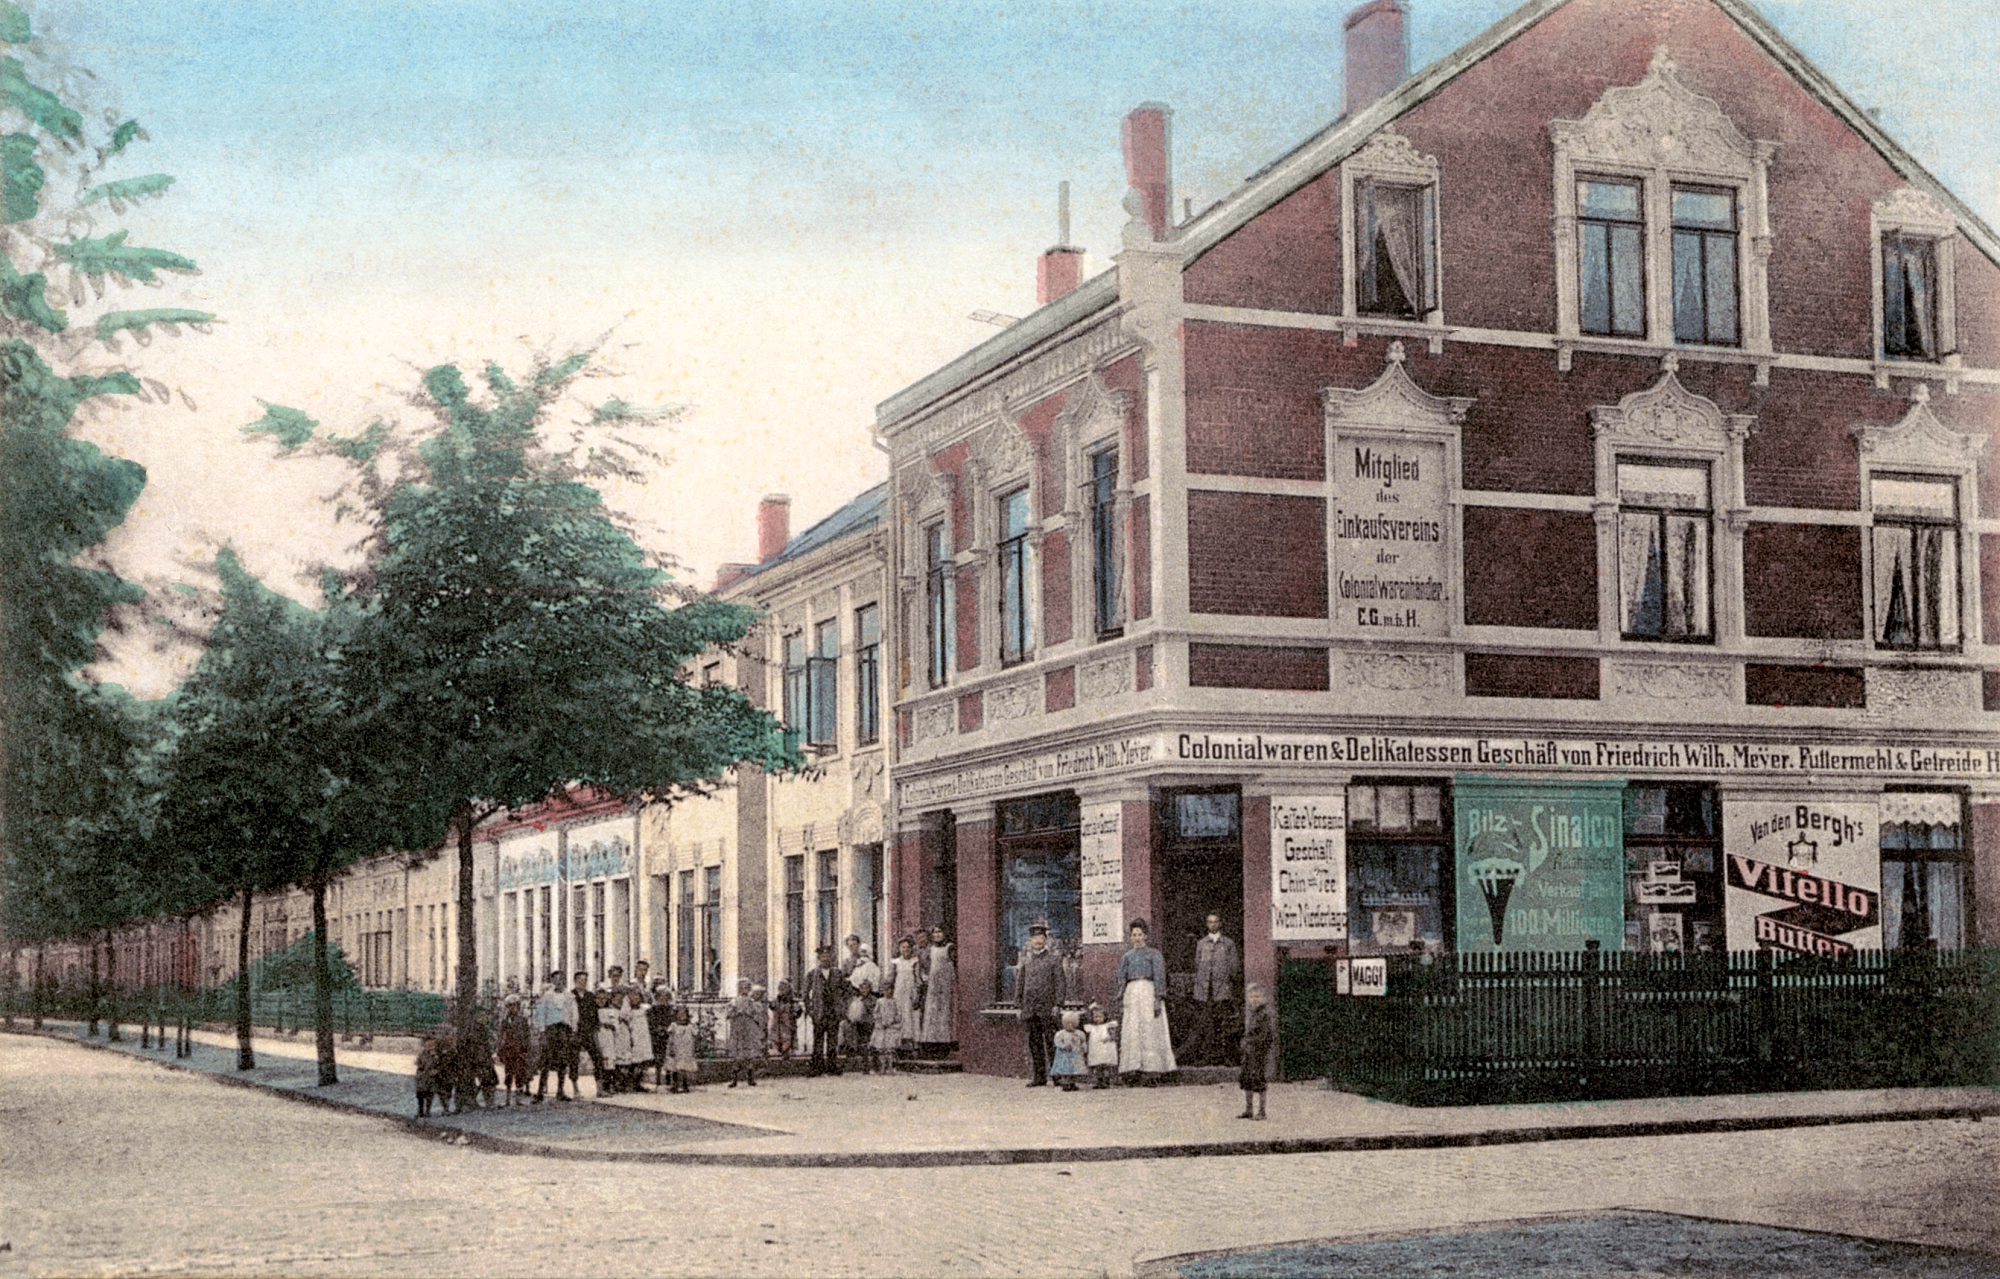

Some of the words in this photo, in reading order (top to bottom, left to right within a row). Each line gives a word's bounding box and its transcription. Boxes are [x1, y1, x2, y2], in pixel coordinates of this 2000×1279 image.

[1355, 447, 1420, 487] Mitglied
[1376, 489, 1399, 503] des
[1337, 510, 1439, 542] Einkaufsvereins
[1376, 548, 1399, 564] der
[1178, 733, 1329, 761] Colonialwaren
[1331, 740, 1344, 761] &
[1477, 739, 1558, 765] Geschäft
[1562, 748, 1592, 766] von
[1595, 742, 1680, 768] Friedrich
[1684, 744, 1731, 769] Wilh.
[1800, 746, 1892, 770] Futtermehl
[1896, 750, 1908, 771] &
[1910, 749, 1982, 772] Getreide
[1529, 805, 1615, 873] Sinalco
[1751, 820, 1769, 844] Van
[1771, 814, 1791, 834] den
[1796, 805, 1864, 847] Bergh's
[1733, 855, 1869, 917] Vitello
[1510, 907, 1539, 935] 100
[1757, 917, 1847, 957] Butter
